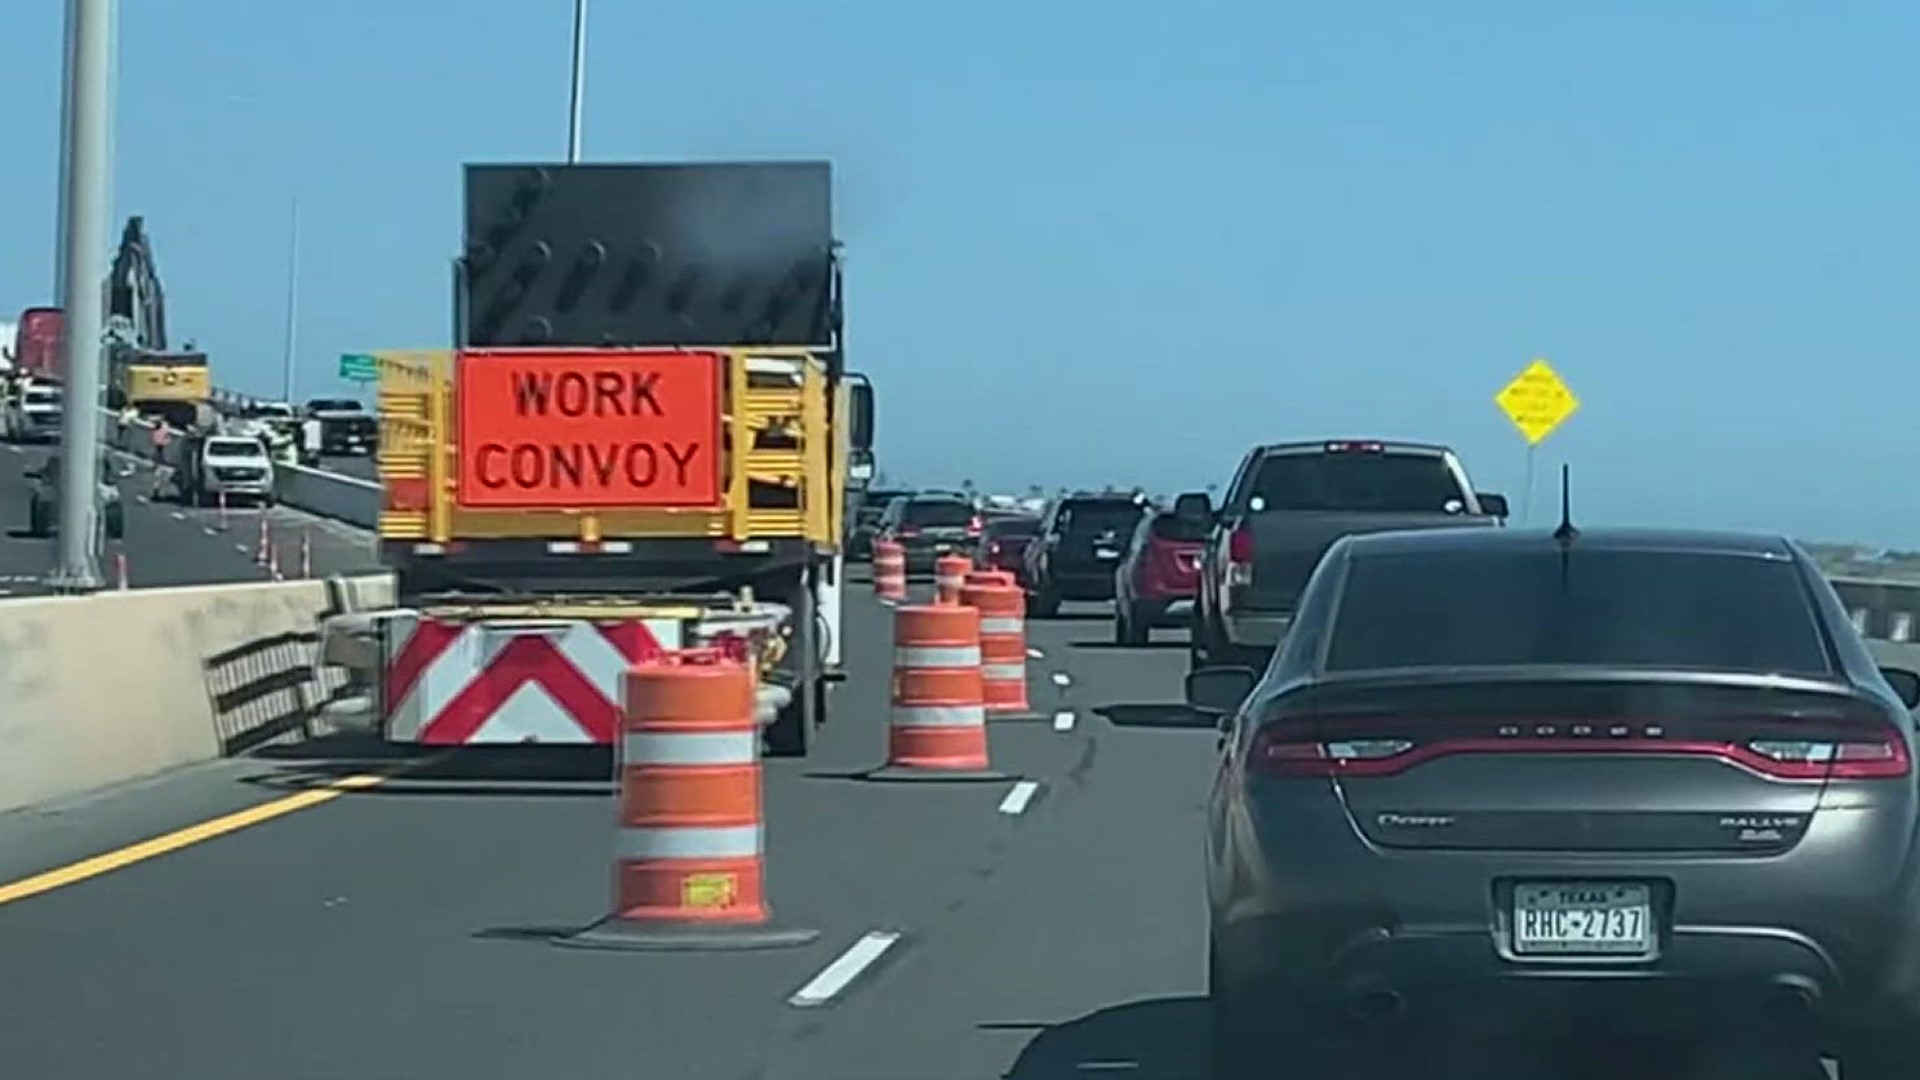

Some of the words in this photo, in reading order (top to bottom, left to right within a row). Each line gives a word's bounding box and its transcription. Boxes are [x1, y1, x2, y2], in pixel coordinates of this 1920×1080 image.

[512, 370, 665, 418] WORK
[474, 442, 700, 489] CONVOY
[1559, 891, 1608, 904] TEXAS
